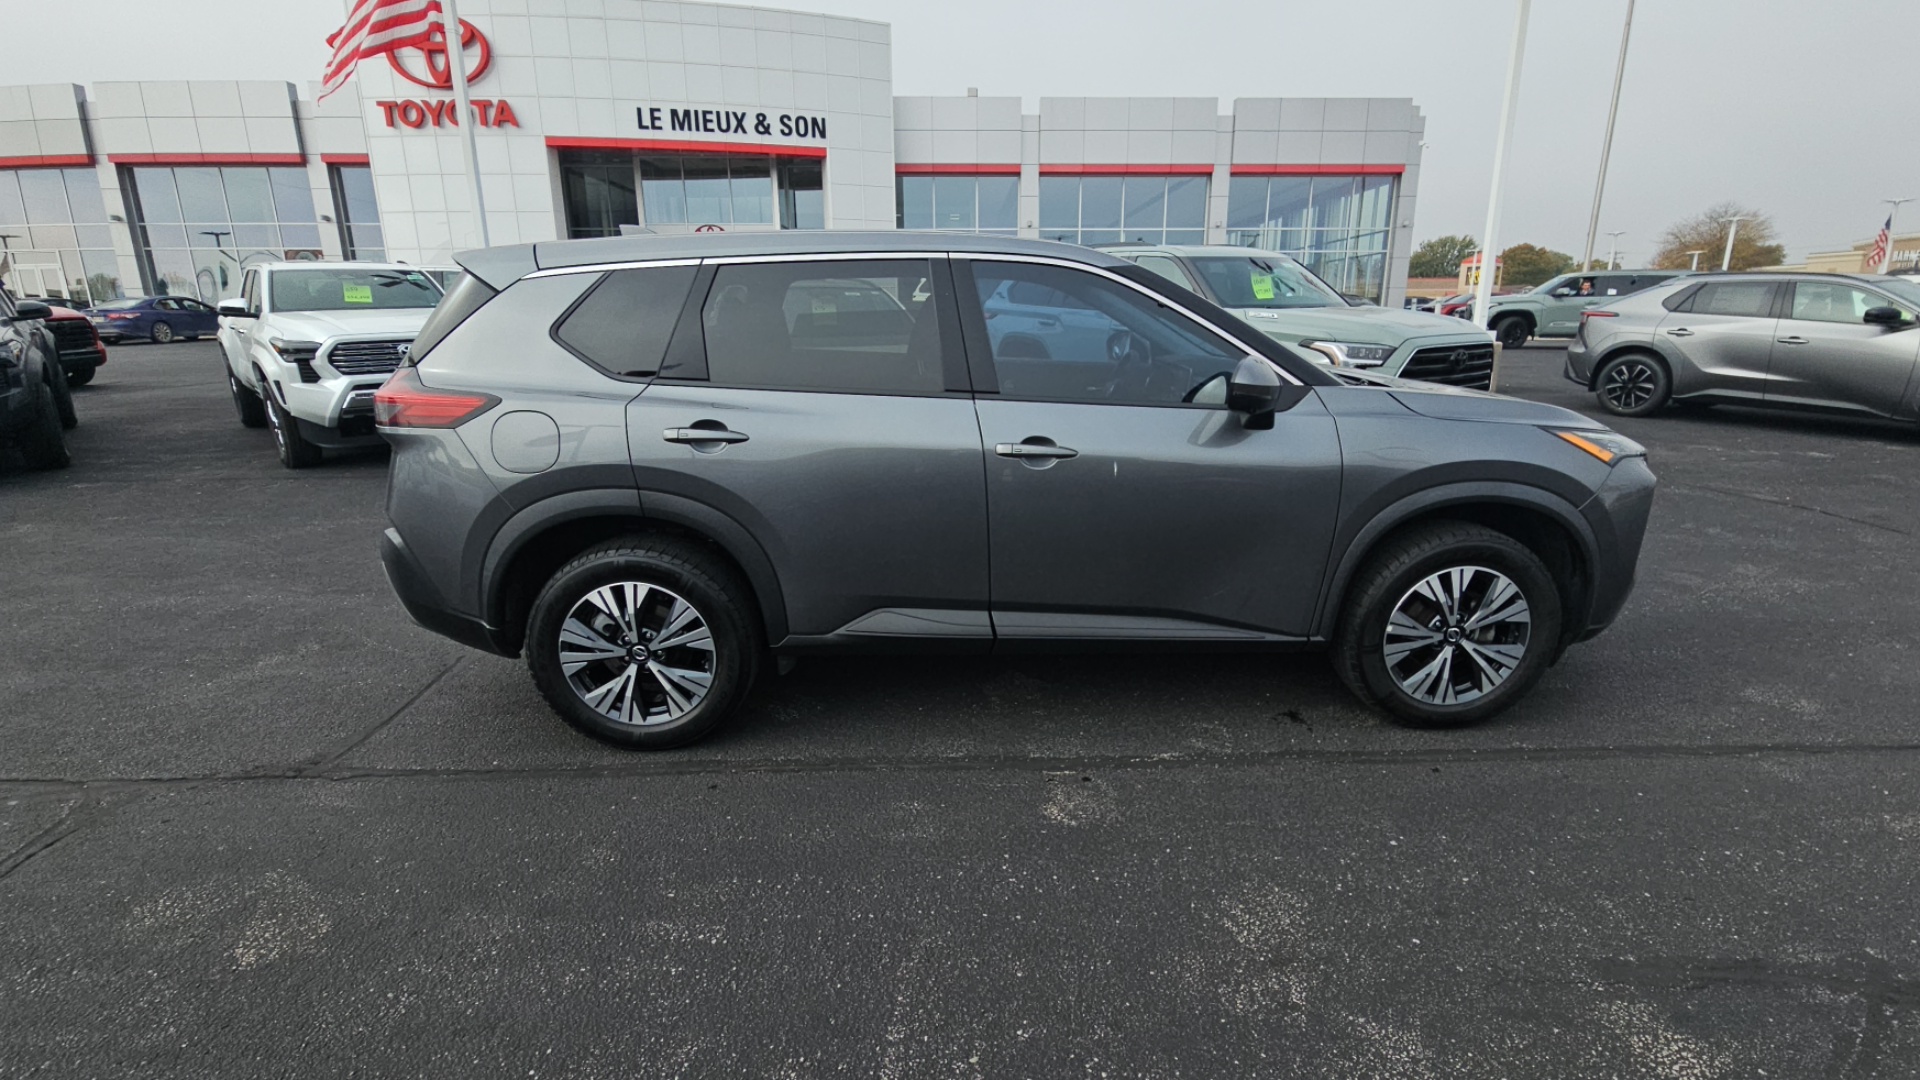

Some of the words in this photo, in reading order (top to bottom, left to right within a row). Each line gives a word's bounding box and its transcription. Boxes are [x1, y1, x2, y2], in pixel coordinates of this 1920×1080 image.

[636, 107, 663, 130] LE
[670, 108, 748, 134] MIEUX
[754, 112, 772, 136] &
[779, 114, 827, 139] SON
